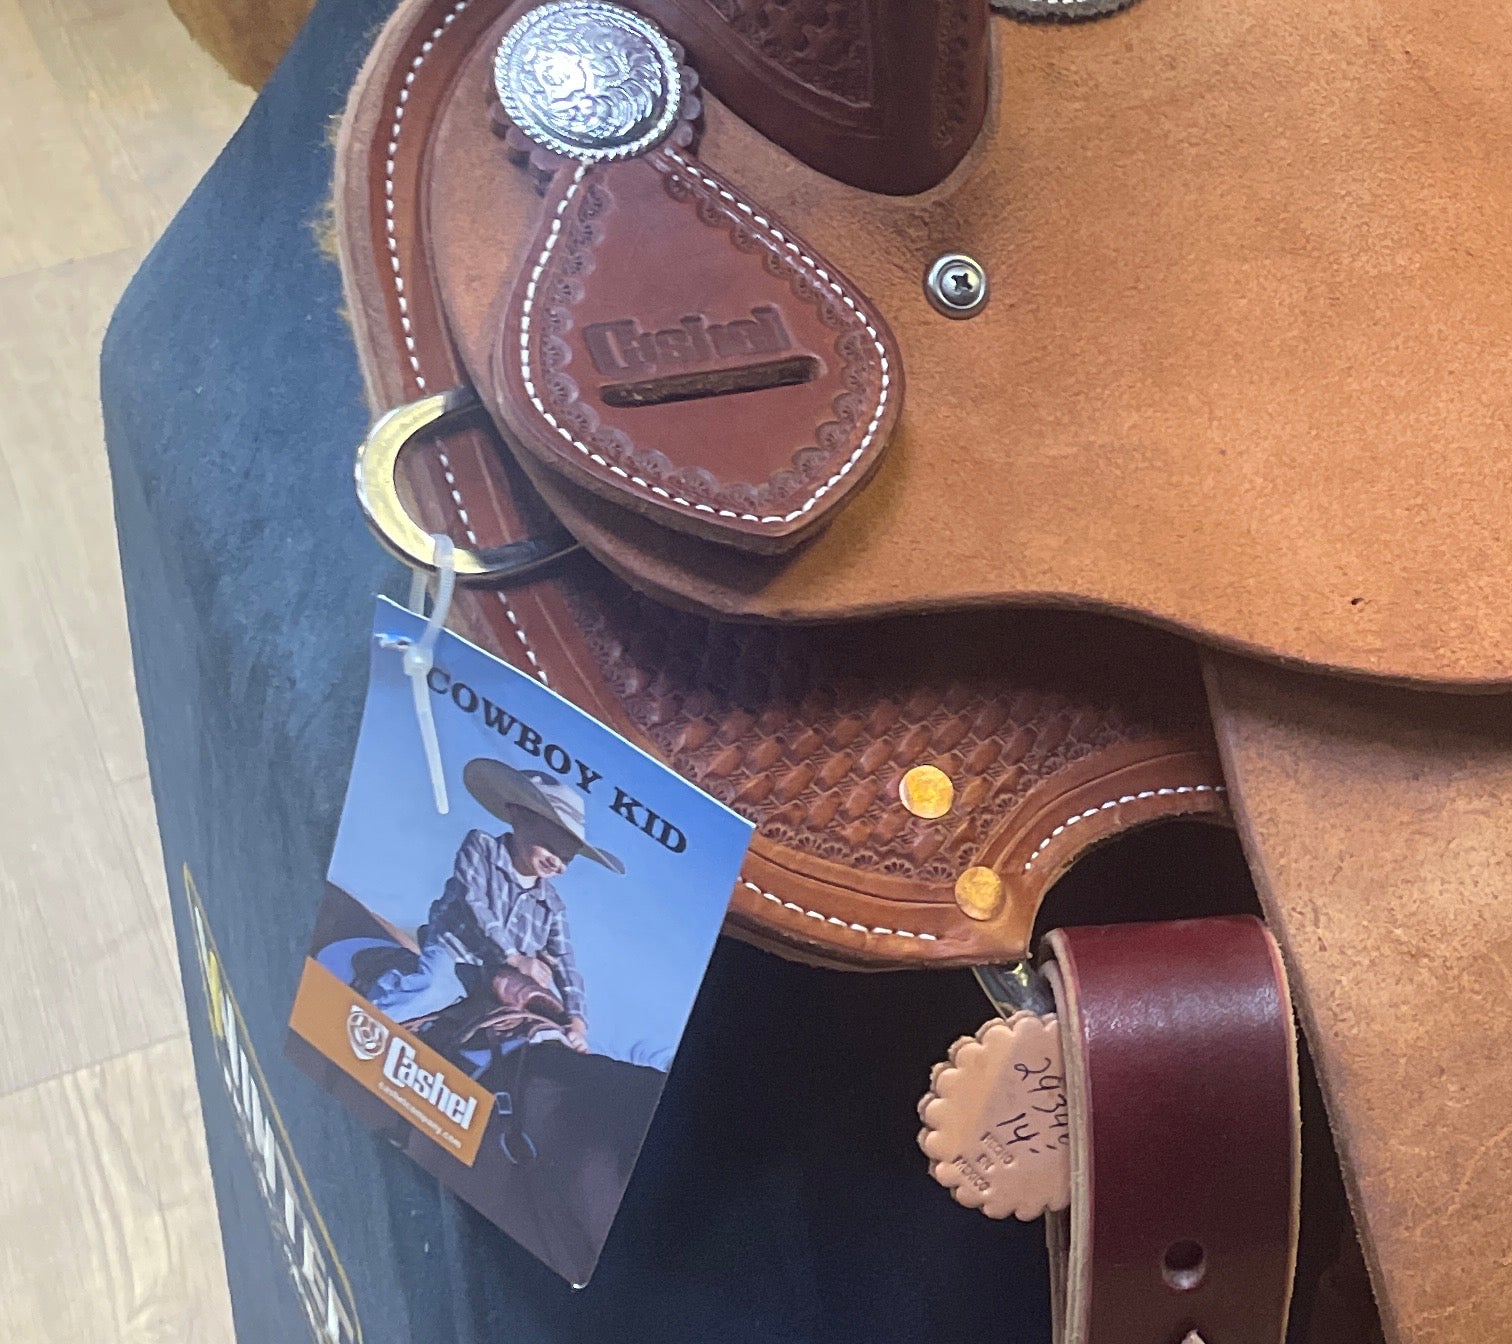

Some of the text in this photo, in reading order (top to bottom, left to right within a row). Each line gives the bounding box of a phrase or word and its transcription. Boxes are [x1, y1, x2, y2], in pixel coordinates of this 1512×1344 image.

[426, 667, 688, 854] COWBOY KID
[383, 1036, 478, 1130] Cashel
